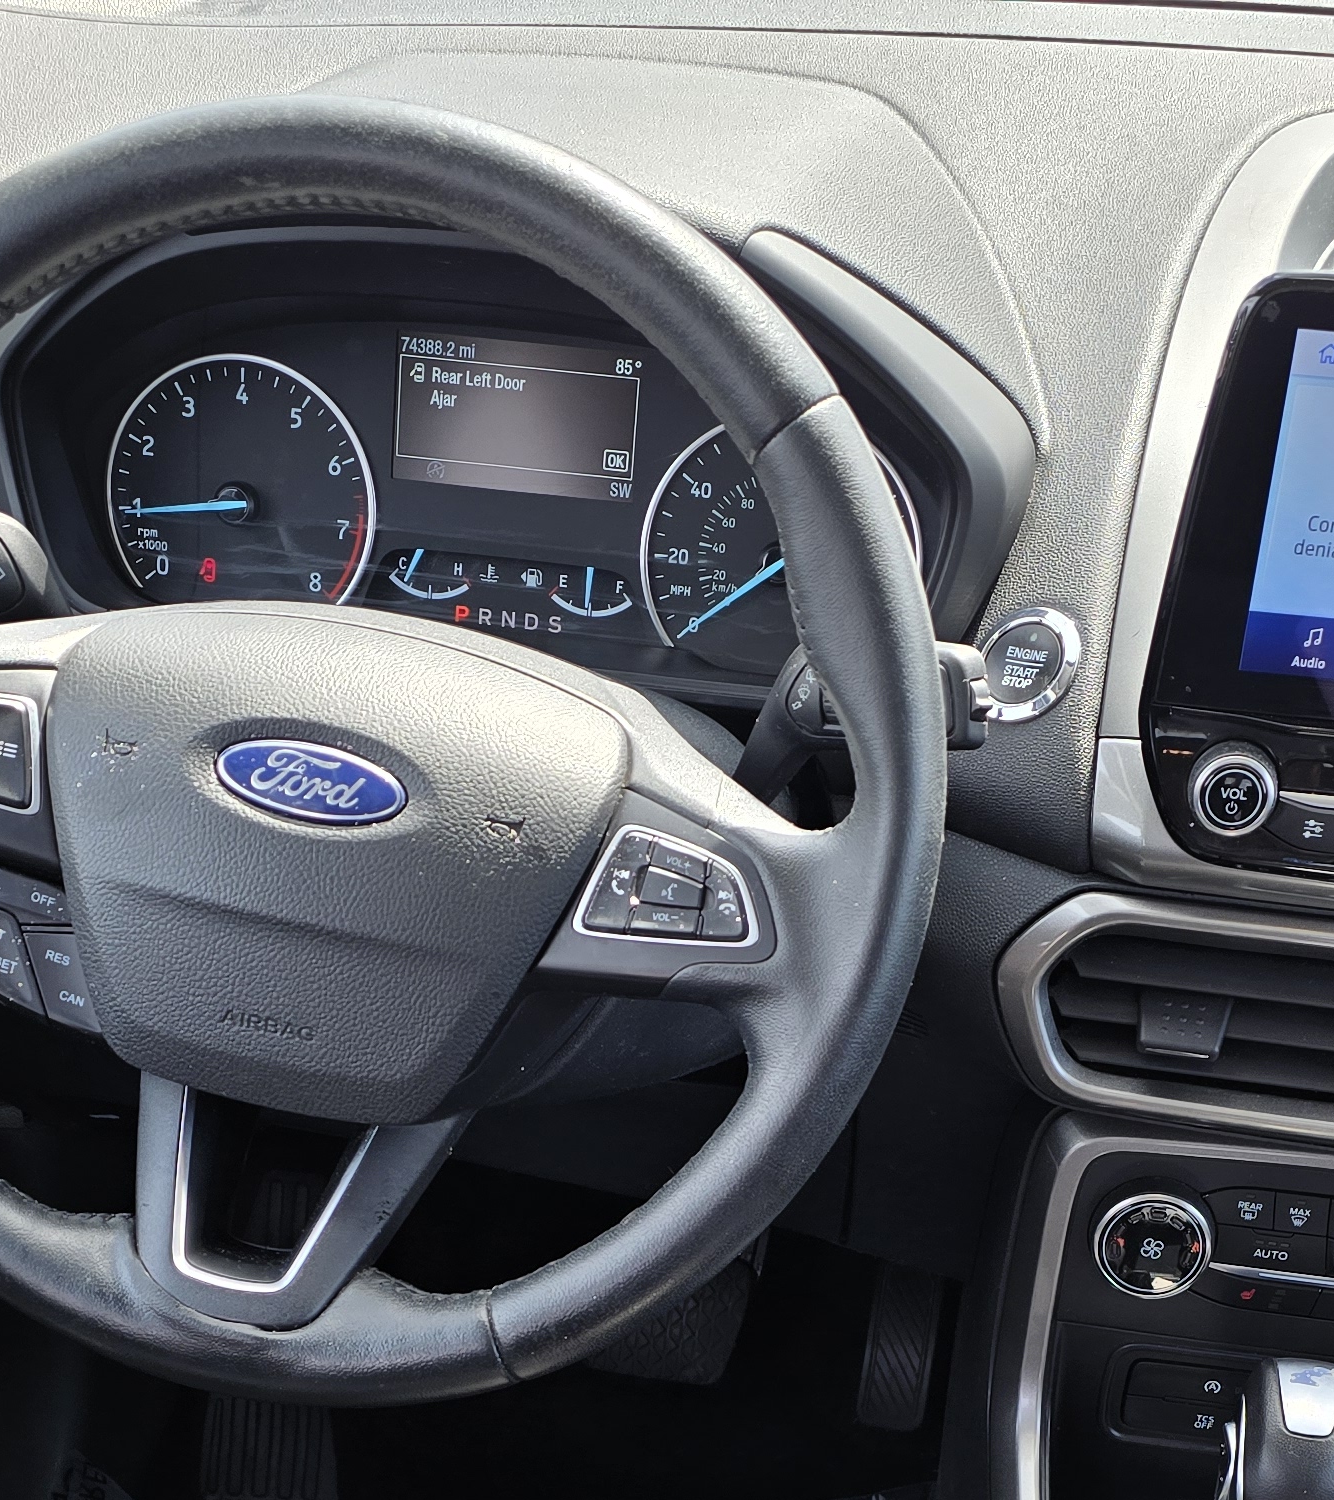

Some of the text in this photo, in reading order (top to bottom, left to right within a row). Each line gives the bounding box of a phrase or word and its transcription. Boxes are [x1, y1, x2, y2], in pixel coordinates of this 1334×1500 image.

[400, 336, 476, 358] 74388.2 mi
[431, 366, 526, 392] Rear Left Door
[235, 384, 248, 404] 4
[430, 389, 457, 409] Ajar
[181, 396, 195, 417] 3
[290, 408, 302, 428] 5
[142, 436, 155, 456] 2
[328, 455, 341, 475] 6
[607, 453, 626, 468] OK
[609, 482, 632, 498] SW
[690, 481, 712, 499] 40
[740, 498, 755, 511] 80
[337, 520, 350, 539] 7
[721, 516, 736, 529] 60
[137, 527, 158, 540] rpm
[137, 537, 168, 551] x1000
[712, 542, 727, 555] 40
[398, 556, 407, 569] C
[668, 547, 689, 565] 20
[155, 556, 169, 575] 0
[453, 562, 463, 576] H
[308, 572, 322, 592] 8
[559, 574, 568, 588] E
[712, 569, 727, 582] 20
[615, 580, 624, 594] F
[670, 584, 692, 597] MPH
[712, 581, 737, 594] km/h
[454, 604, 563, 633] P R N D S
[1006, 645, 1048, 661] ENGINE
[1291, 654, 1326, 670] Audio
[1003, 664, 1039, 681] START
[1001, 675, 1033, 689] STOP
[249, 748, 364, 809] Ford
[1221, 787, 1247, 801] VOL
[31, 891, 56, 907] OFF
[45, 949, 71, 966] RES
[59, 990, 85, 1007] CAN
[221, 1006, 316, 1043] AIRBAG
[1237, 1200, 1264, 1213] REAR
[1289, 1206, 1312, 1219] MAX
[1253, 1247, 1288, 1261] AUTO
[1194, 1420, 1213, 1430] OFF
[1197, 1414, 1215, 1424] TCS
